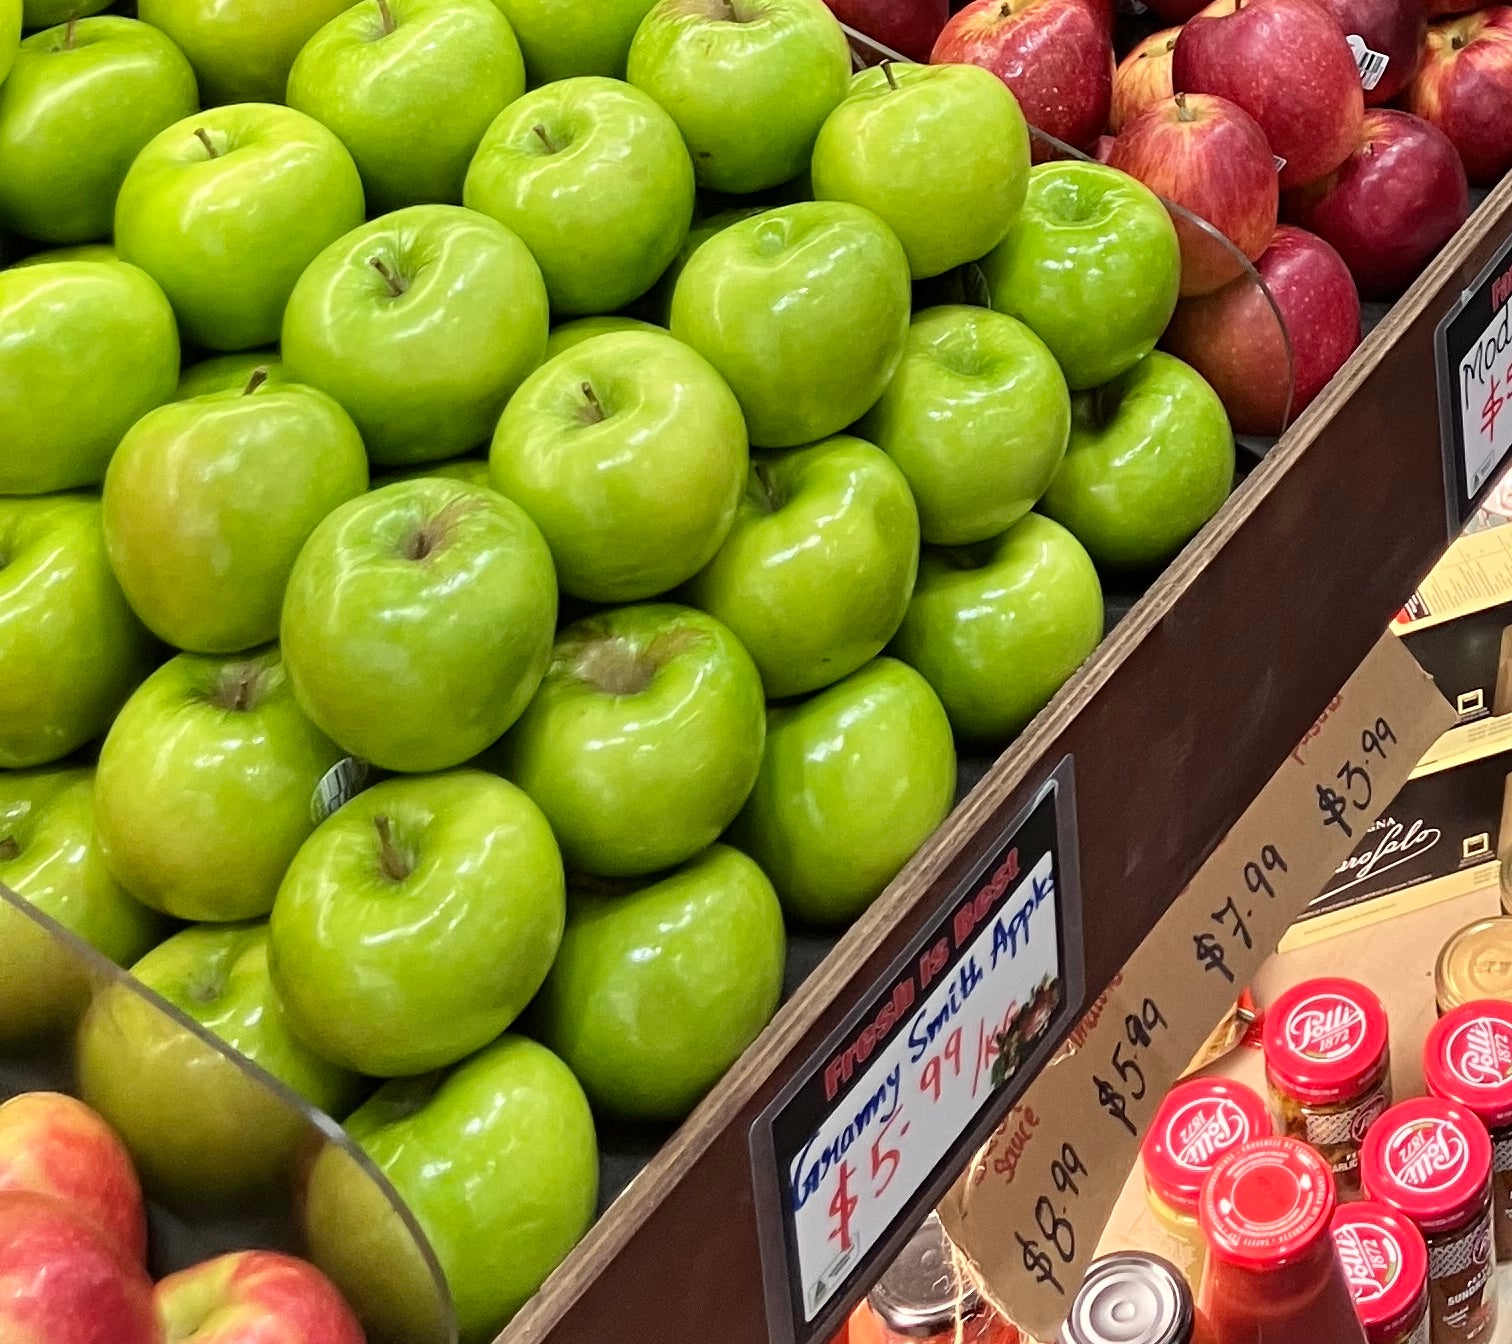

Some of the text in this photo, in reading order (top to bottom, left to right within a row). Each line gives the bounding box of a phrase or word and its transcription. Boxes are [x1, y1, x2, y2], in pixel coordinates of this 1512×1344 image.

[1316, 716, 1397, 838] $3.99
[1193, 844, 1288, 984] $7.99
[822, 976, 916, 1103] Fresh
[952, 847, 1022, 957] Best
[1289, 1004, 1356, 1051] Polli
[1318, 1029, 1351, 1054] 1872
[1460, 1018, 1504, 1086] Polli
[1495, 1032, 1511, 1065] 1872
[790, 1056, 902, 1214] Granny
[907, 952, 983, 1066] Smith
[1092, 997, 1167, 1136] $5.99
[994, 1105, 1040, 1186] Sauce
[1179, 1109, 1208, 1145] 1872
[1186, 1101, 1246, 1164] Polli
[1397, 1120, 1464, 1186] Polli
[1398, 1128, 1426, 1165] 1872
[1014, 1140, 1089, 1299] $8.99
[1365, 1238, 1389, 1270] 1872
